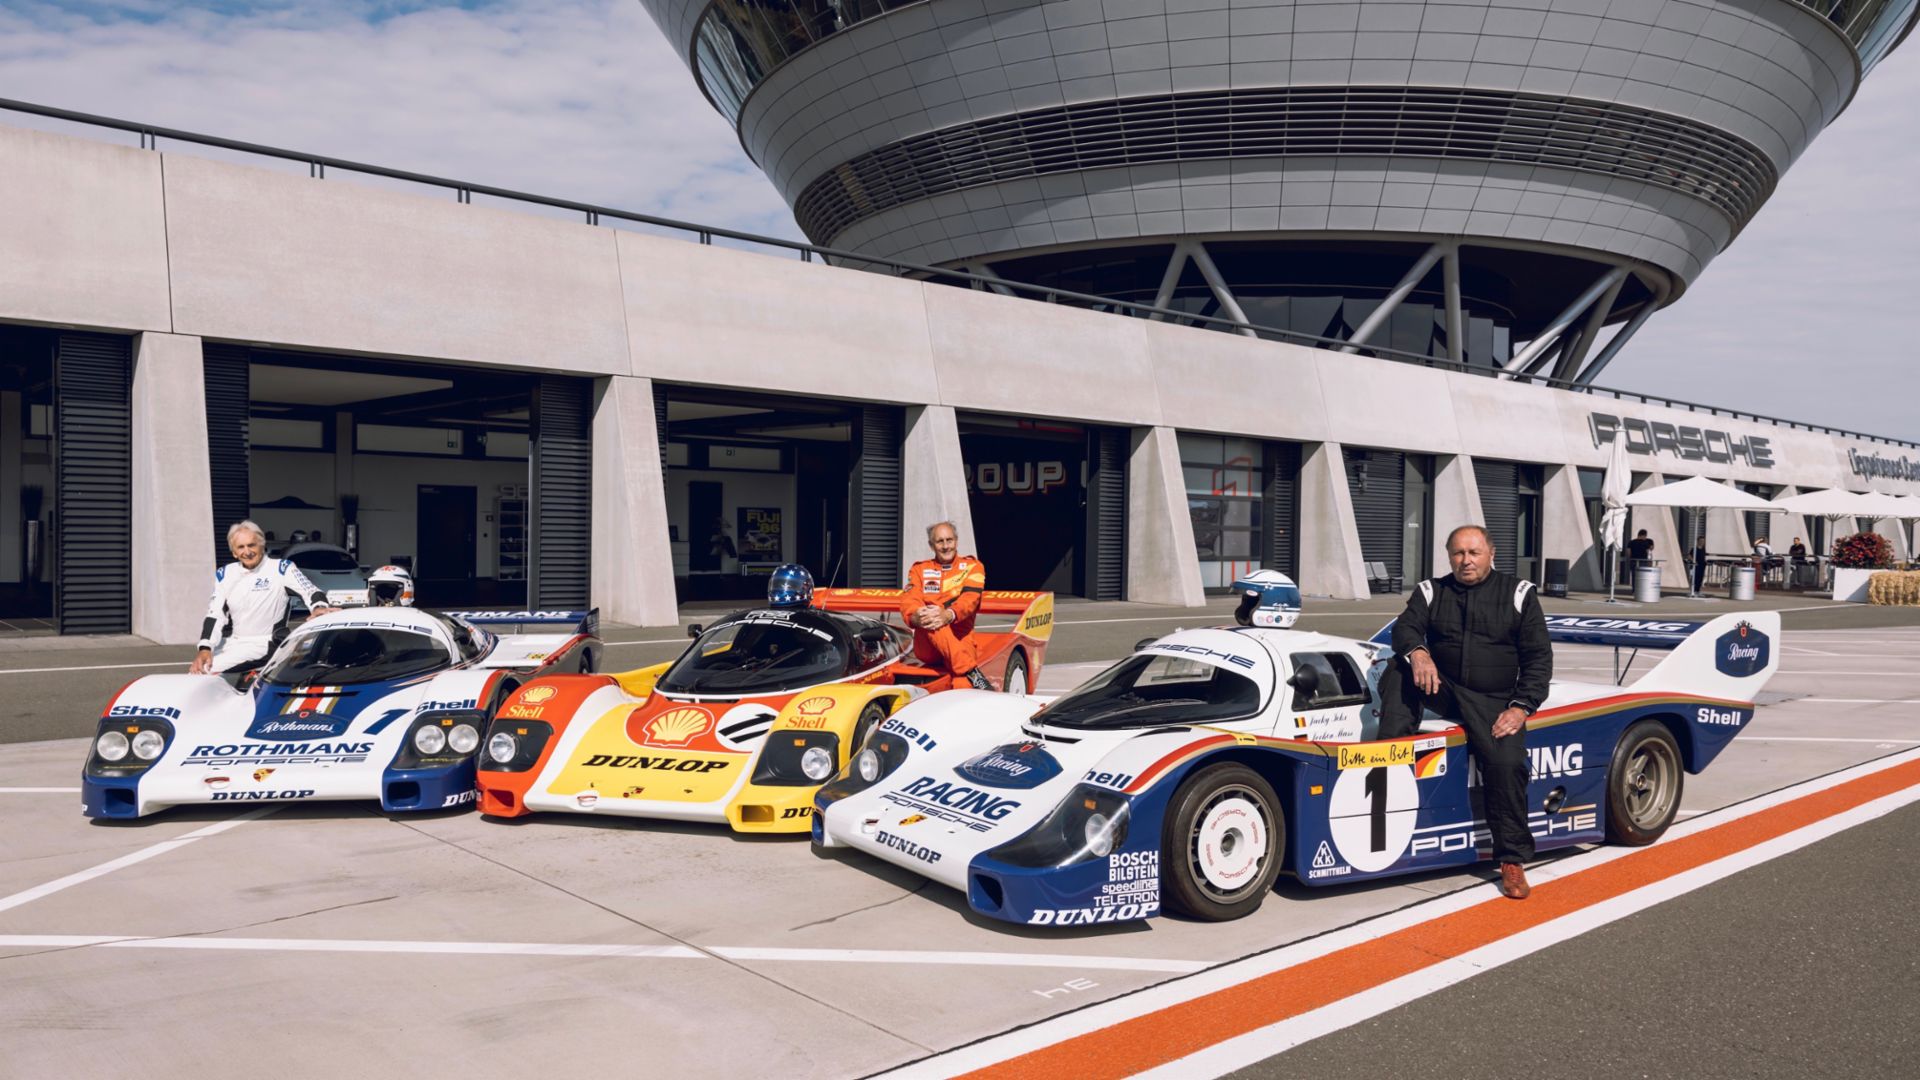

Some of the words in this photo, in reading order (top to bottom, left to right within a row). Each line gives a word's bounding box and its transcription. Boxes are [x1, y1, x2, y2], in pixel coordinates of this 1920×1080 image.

[1587, 410, 1775, 469] PORSCHE
[964, 460, 1067, 495] OUP
[746, 511, 781, 523] FUJI
[861, 588, 904, 597] Shel
[441, 610, 573, 620] THMANS
[1024, 612, 1052, 630] DUNLOP
[1546, 615, 1691, 631] ACING
[1728, 643, 1759, 661] Racing
[111, 705, 182, 720] Shell
[415, 699, 477, 715] Shell
[505, 704, 545, 719] Shell
[362, 708, 413, 735] 1
[785, 716, 827, 729] Shell
[1697, 708, 1741, 726] Shell
[256, 721, 335, 733] Rothmans
[882, 718, 938, 752] Shell
[190, 742, 375, 757] ROTHMANS
[1341, 747, 1366, 768] Bitte
[1370, 754, 1386, 764] ein
[1389, 743, 1415, 762] Bit!
[180, 756, 368, 767] PORSCHE
[581, 754, 730, 773] DUNLOP
[980, 753, 1033, 776] Racing
[1085, 768, 1132, 789] hell
[210, 789, 315, 801] DUNLOP
[900, 776, 1022, 820] RACING
[879, 794, 993, 833] PORSCHE
[1364, 766, 1388, 853] 1
[1411, 812, 1597, 857] PORCHE
[875, 830, 942, 864] DUNLOP
[1109, 850, 1159, 868] BOSCH
[1109, 864, 1158, 882] BILSTEIN
[1093, 891, 1160, 907] TELETRON
[1027, 901, 1160, 925] DUNLOP
